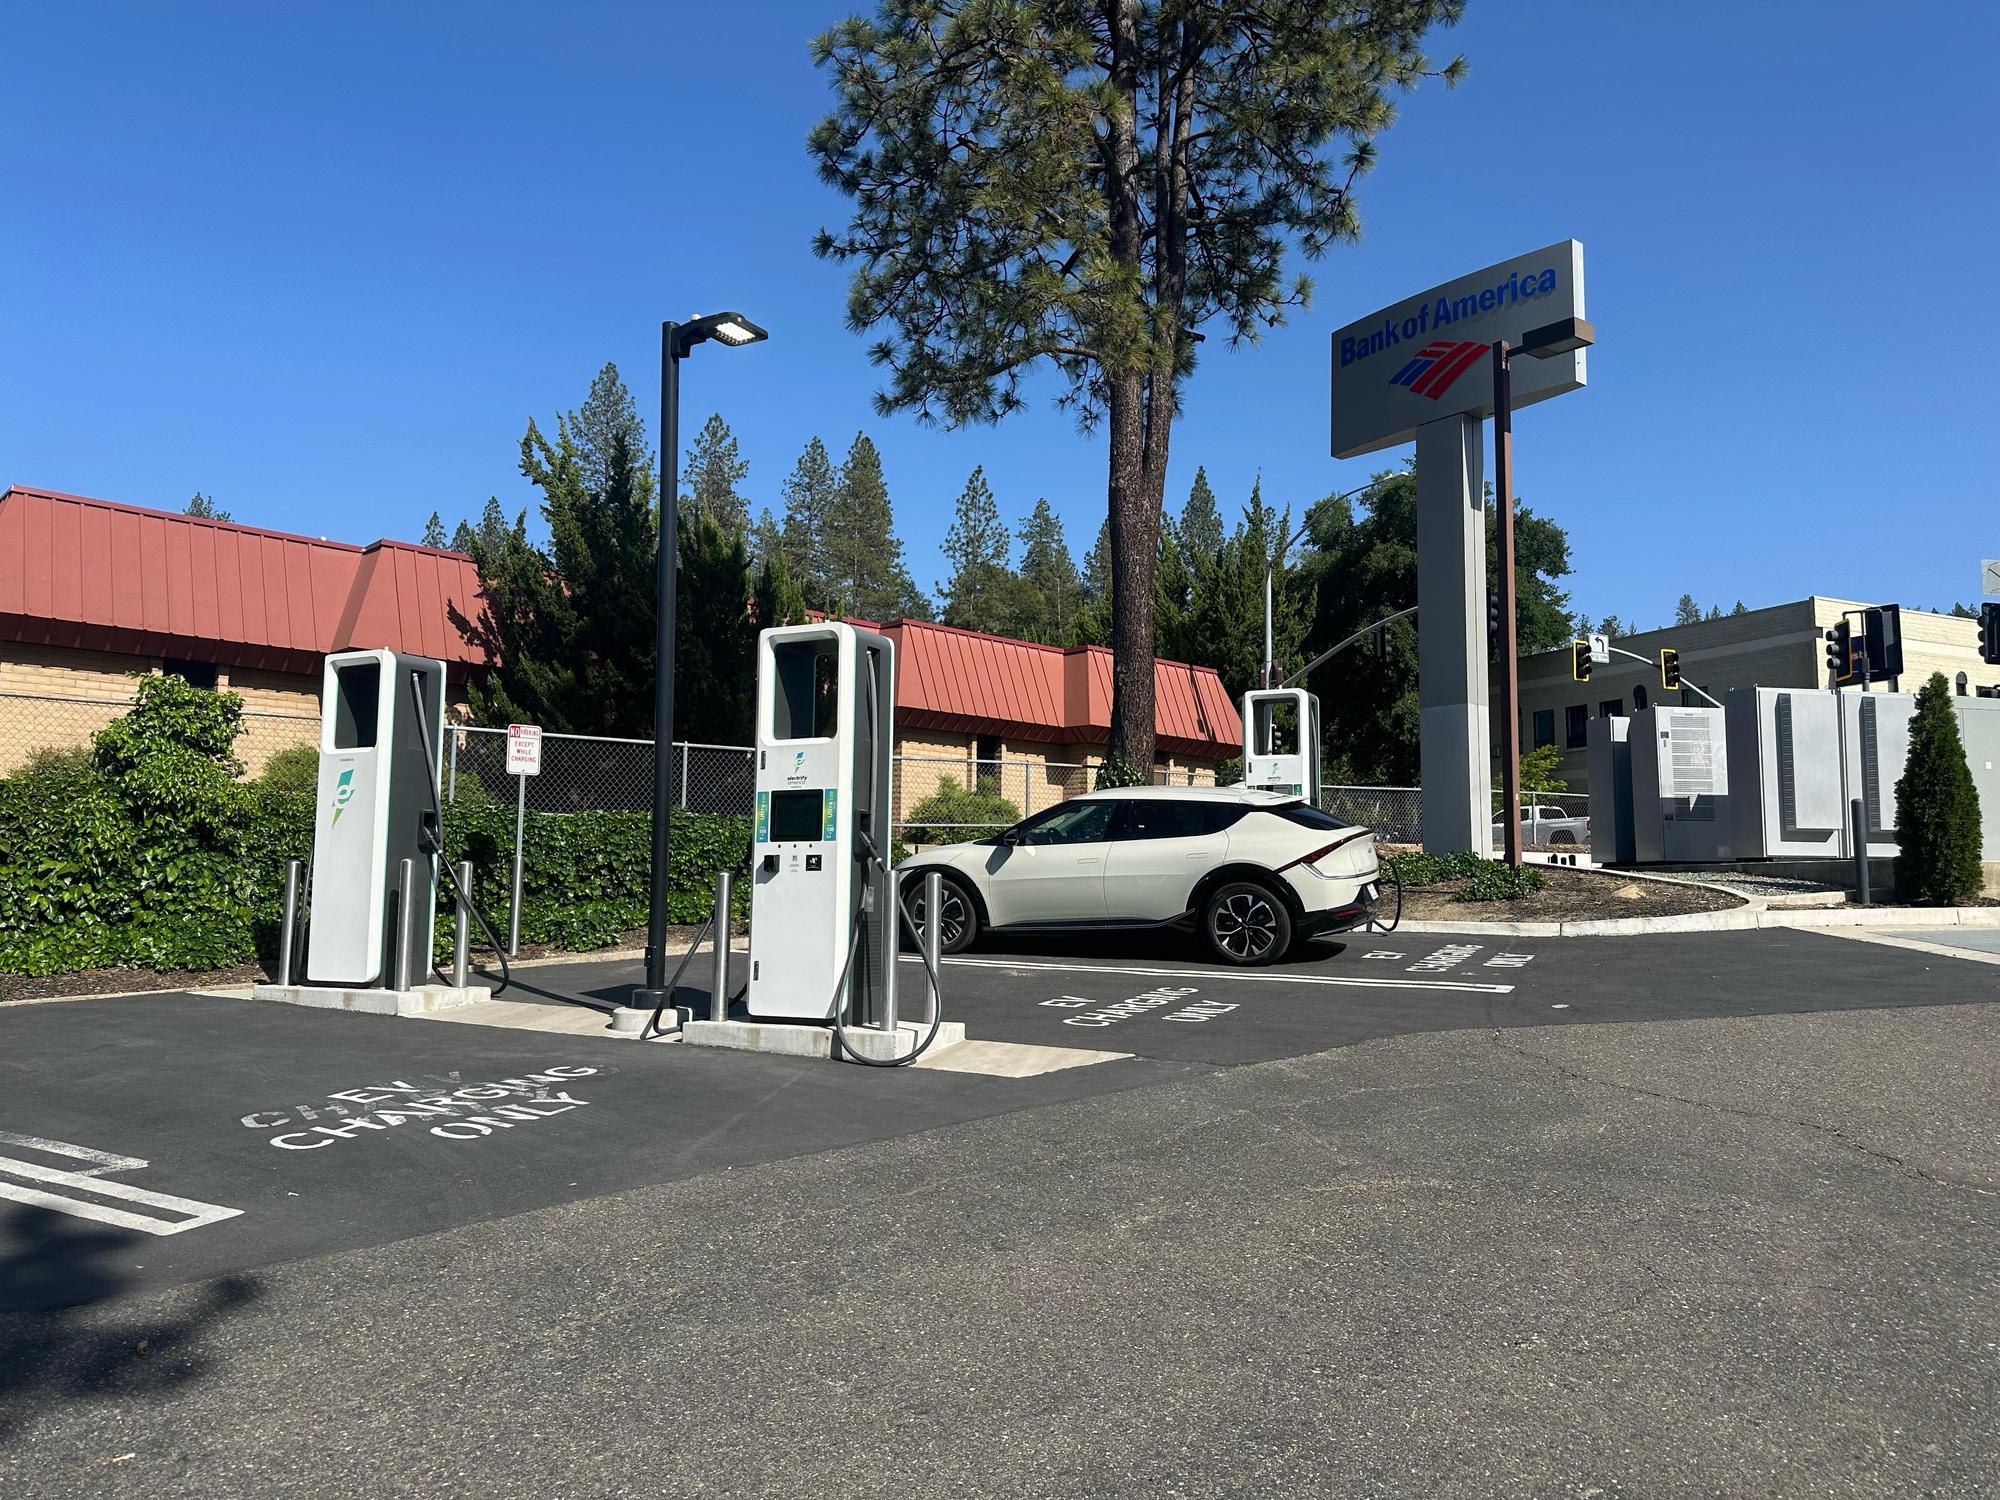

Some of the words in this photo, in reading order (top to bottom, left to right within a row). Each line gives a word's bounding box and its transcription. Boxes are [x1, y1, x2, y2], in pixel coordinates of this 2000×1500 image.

[1341, 319, 1400, 368] Bank
[1402, 303, 1429, 340] of
[1433, 268, 1556, 330] America
[511, 727, 520, 737] NO
[1038, 995, 1096, 1008] EV
[1062, 987, 1199, 1027] CHARGING
[1161, 1000, 1240, 1022] ONLY
[327, 1080, 420, 1103] EV
[269, 1066, 598, 1150] CHARGING
[430, 1091, 590, 1139] ONLY
